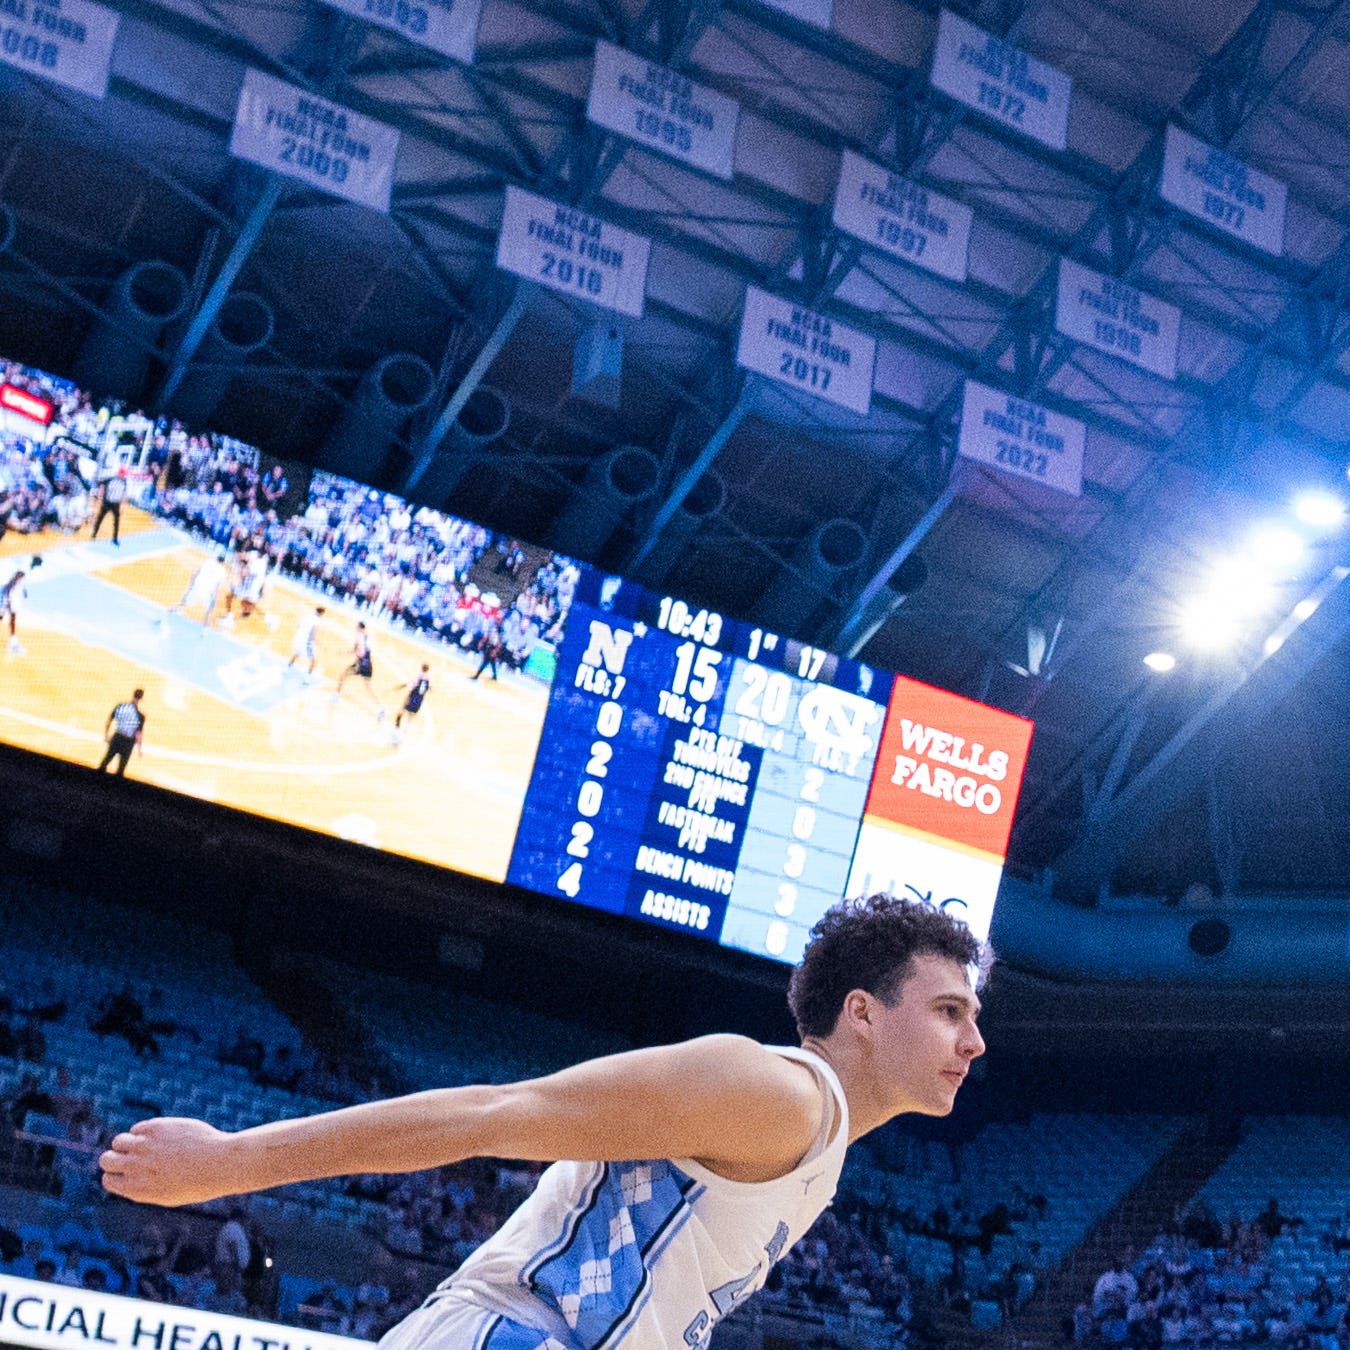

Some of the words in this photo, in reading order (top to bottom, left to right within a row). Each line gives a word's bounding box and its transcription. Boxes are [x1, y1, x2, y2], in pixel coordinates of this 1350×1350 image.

[0, 24, 59, 68] 008
[281, 138, 349, 184] 2009
[780, 351, 832, 391] 2017
[658, 597, 723, 646] 10:43
[672, 642, 723, 702] 15
[798, 645, 828, 680] 17
[735, 664, 793, 725] 20
[596, 701, 623, 737] 0
[693, 703, 706, 727] 4
[585, 740, 613, 778] 2
[900, 718, 1009, 782] WELLS
[577, 780, 604, 817] 0
[800, 767, 825, 803] 2
[891, 754, 1002, 815] FARGO
[566, 821, 594, 859] 2
[556, 861, 583, 897] 4
[635, 844, 683, 881] BENCH
[683, 858, 735, 896] POINTS
[783, 843, 808, 878] 3
[640, 889, 711, 931] ASSISTS
[773, 882, 799, 917] 3
